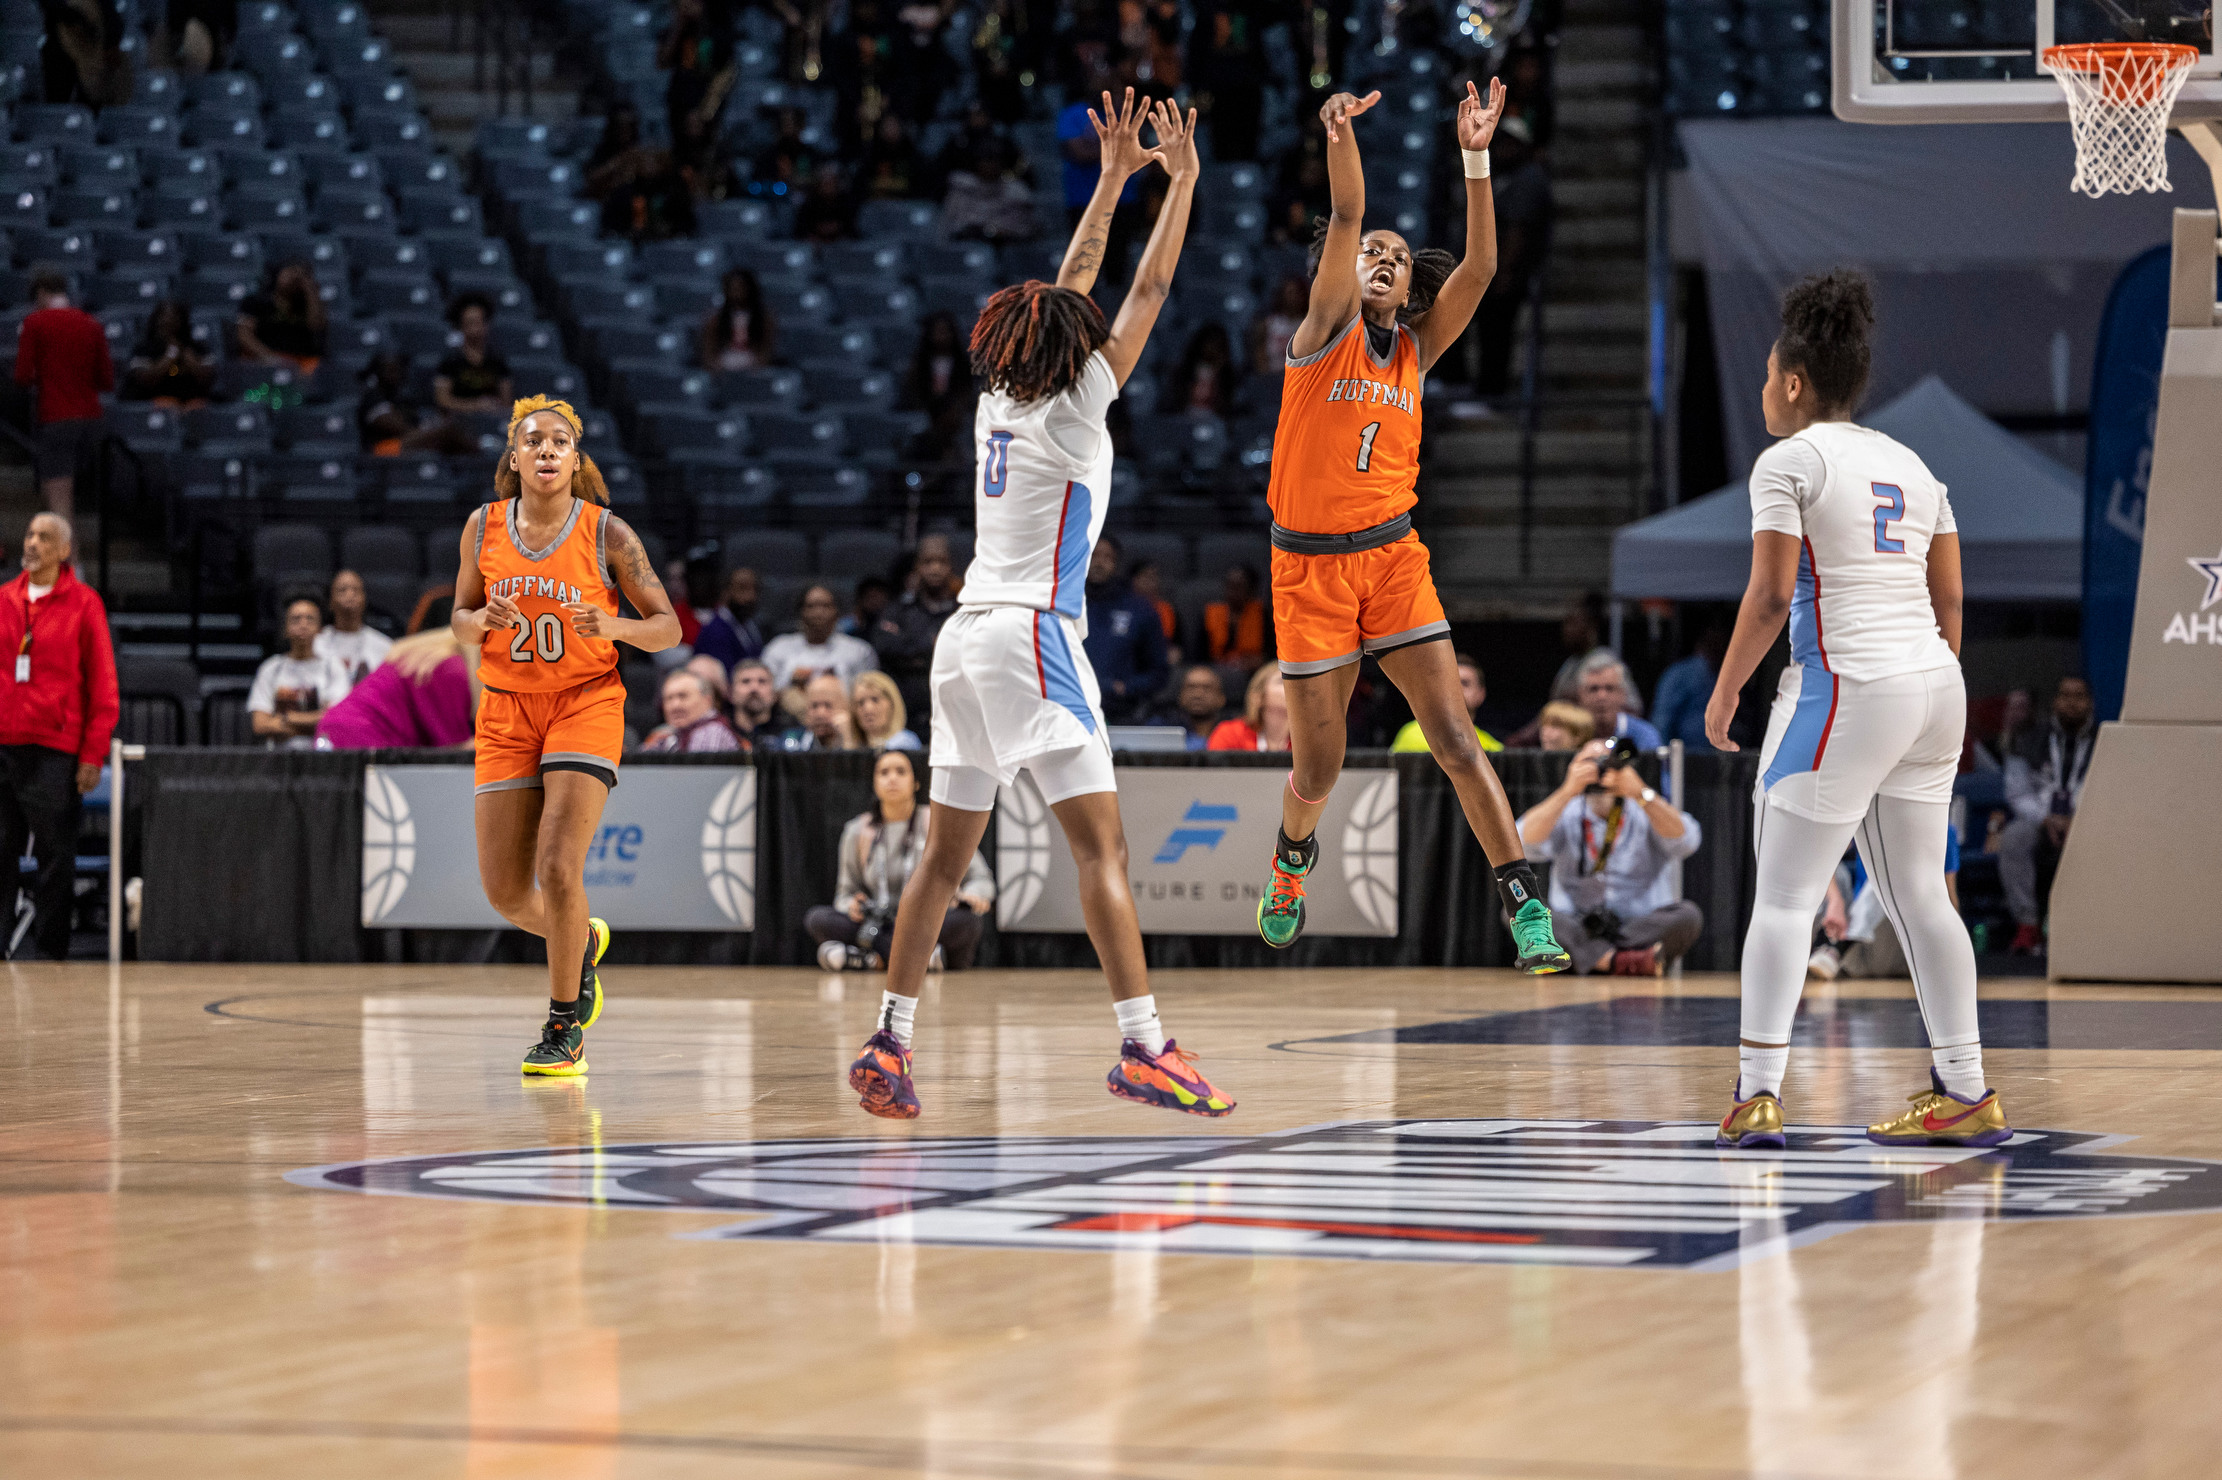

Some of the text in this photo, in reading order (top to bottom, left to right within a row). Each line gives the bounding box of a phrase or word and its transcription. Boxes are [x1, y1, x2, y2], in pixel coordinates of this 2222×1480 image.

[1326, 378, 1415, 417] HUFFMAN
[983, 429, 1015, 498] 0
[1356, 421, 1381, 473] 1
[1871, 481, 1906, 554] 2
[489, 575, 582, 603] HUFFMAN
[510, 611, 566, 663] 20
[2163, 611, 2222, 646] AH
[586, 824, 644, 861] re
[1132, 880, 1260, 902] TURE ON
